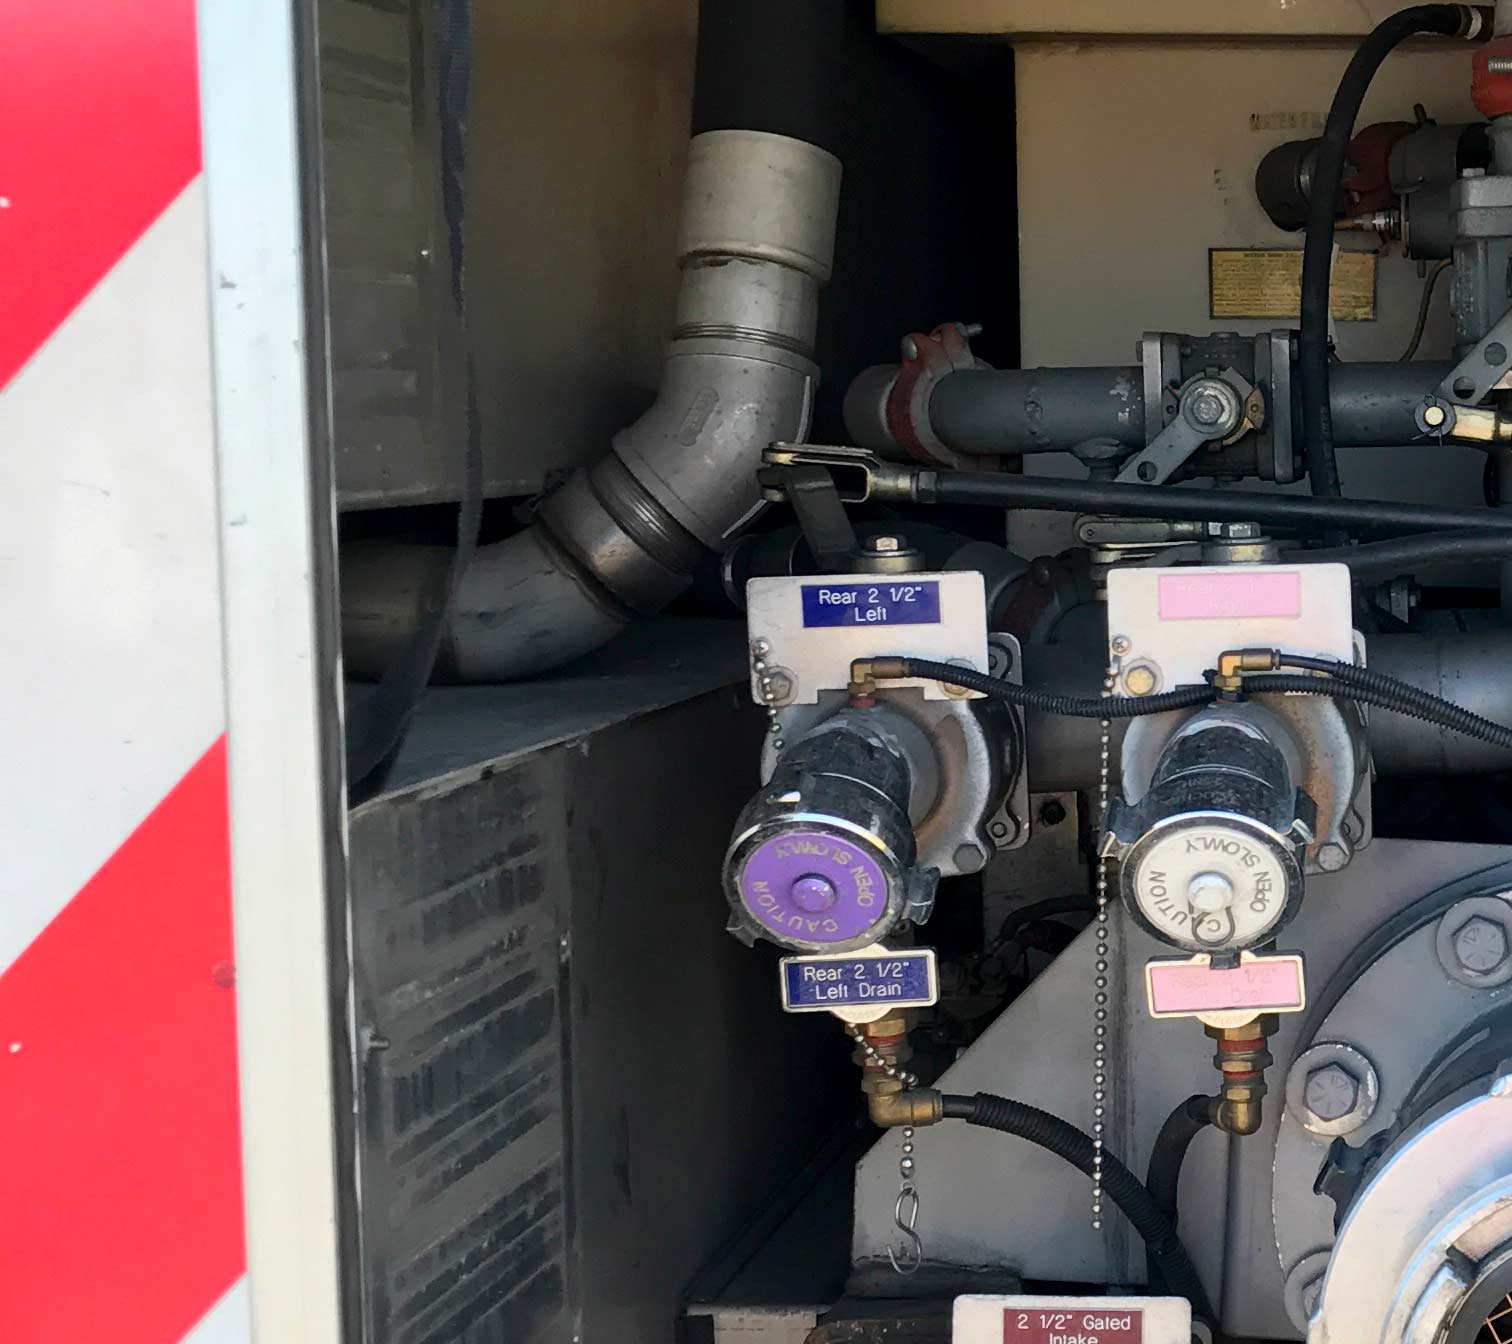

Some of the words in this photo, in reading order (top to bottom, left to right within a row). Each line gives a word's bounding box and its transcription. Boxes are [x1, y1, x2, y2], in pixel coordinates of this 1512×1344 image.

[818, 589, 858, 605] Rear
[867, 588, 880, 604] 2
[889, 586, 922, 602] 1/2"
[854, 607, 887, 622] Left
[1185, 836, 1261, 868] SLOWLY
[851, 866, 876, 907] OPEN
[1250, 871, 1273, 913] OPEN
[752, 881, 839, 933] CAUTION
[803, 966, 843, 982] Rear
[853, 964, 867, 980] 2
[876, 962, 910, 978] 1/2"
[815, 983, 849, 1000] Left
[858, 983, 902, 998] Drain
[1017, 1313, 1030, 1330] 2
[1039, 1313, 1073, 1330] 1/2"
[1082, 1314, 1132, 1331] Gated
